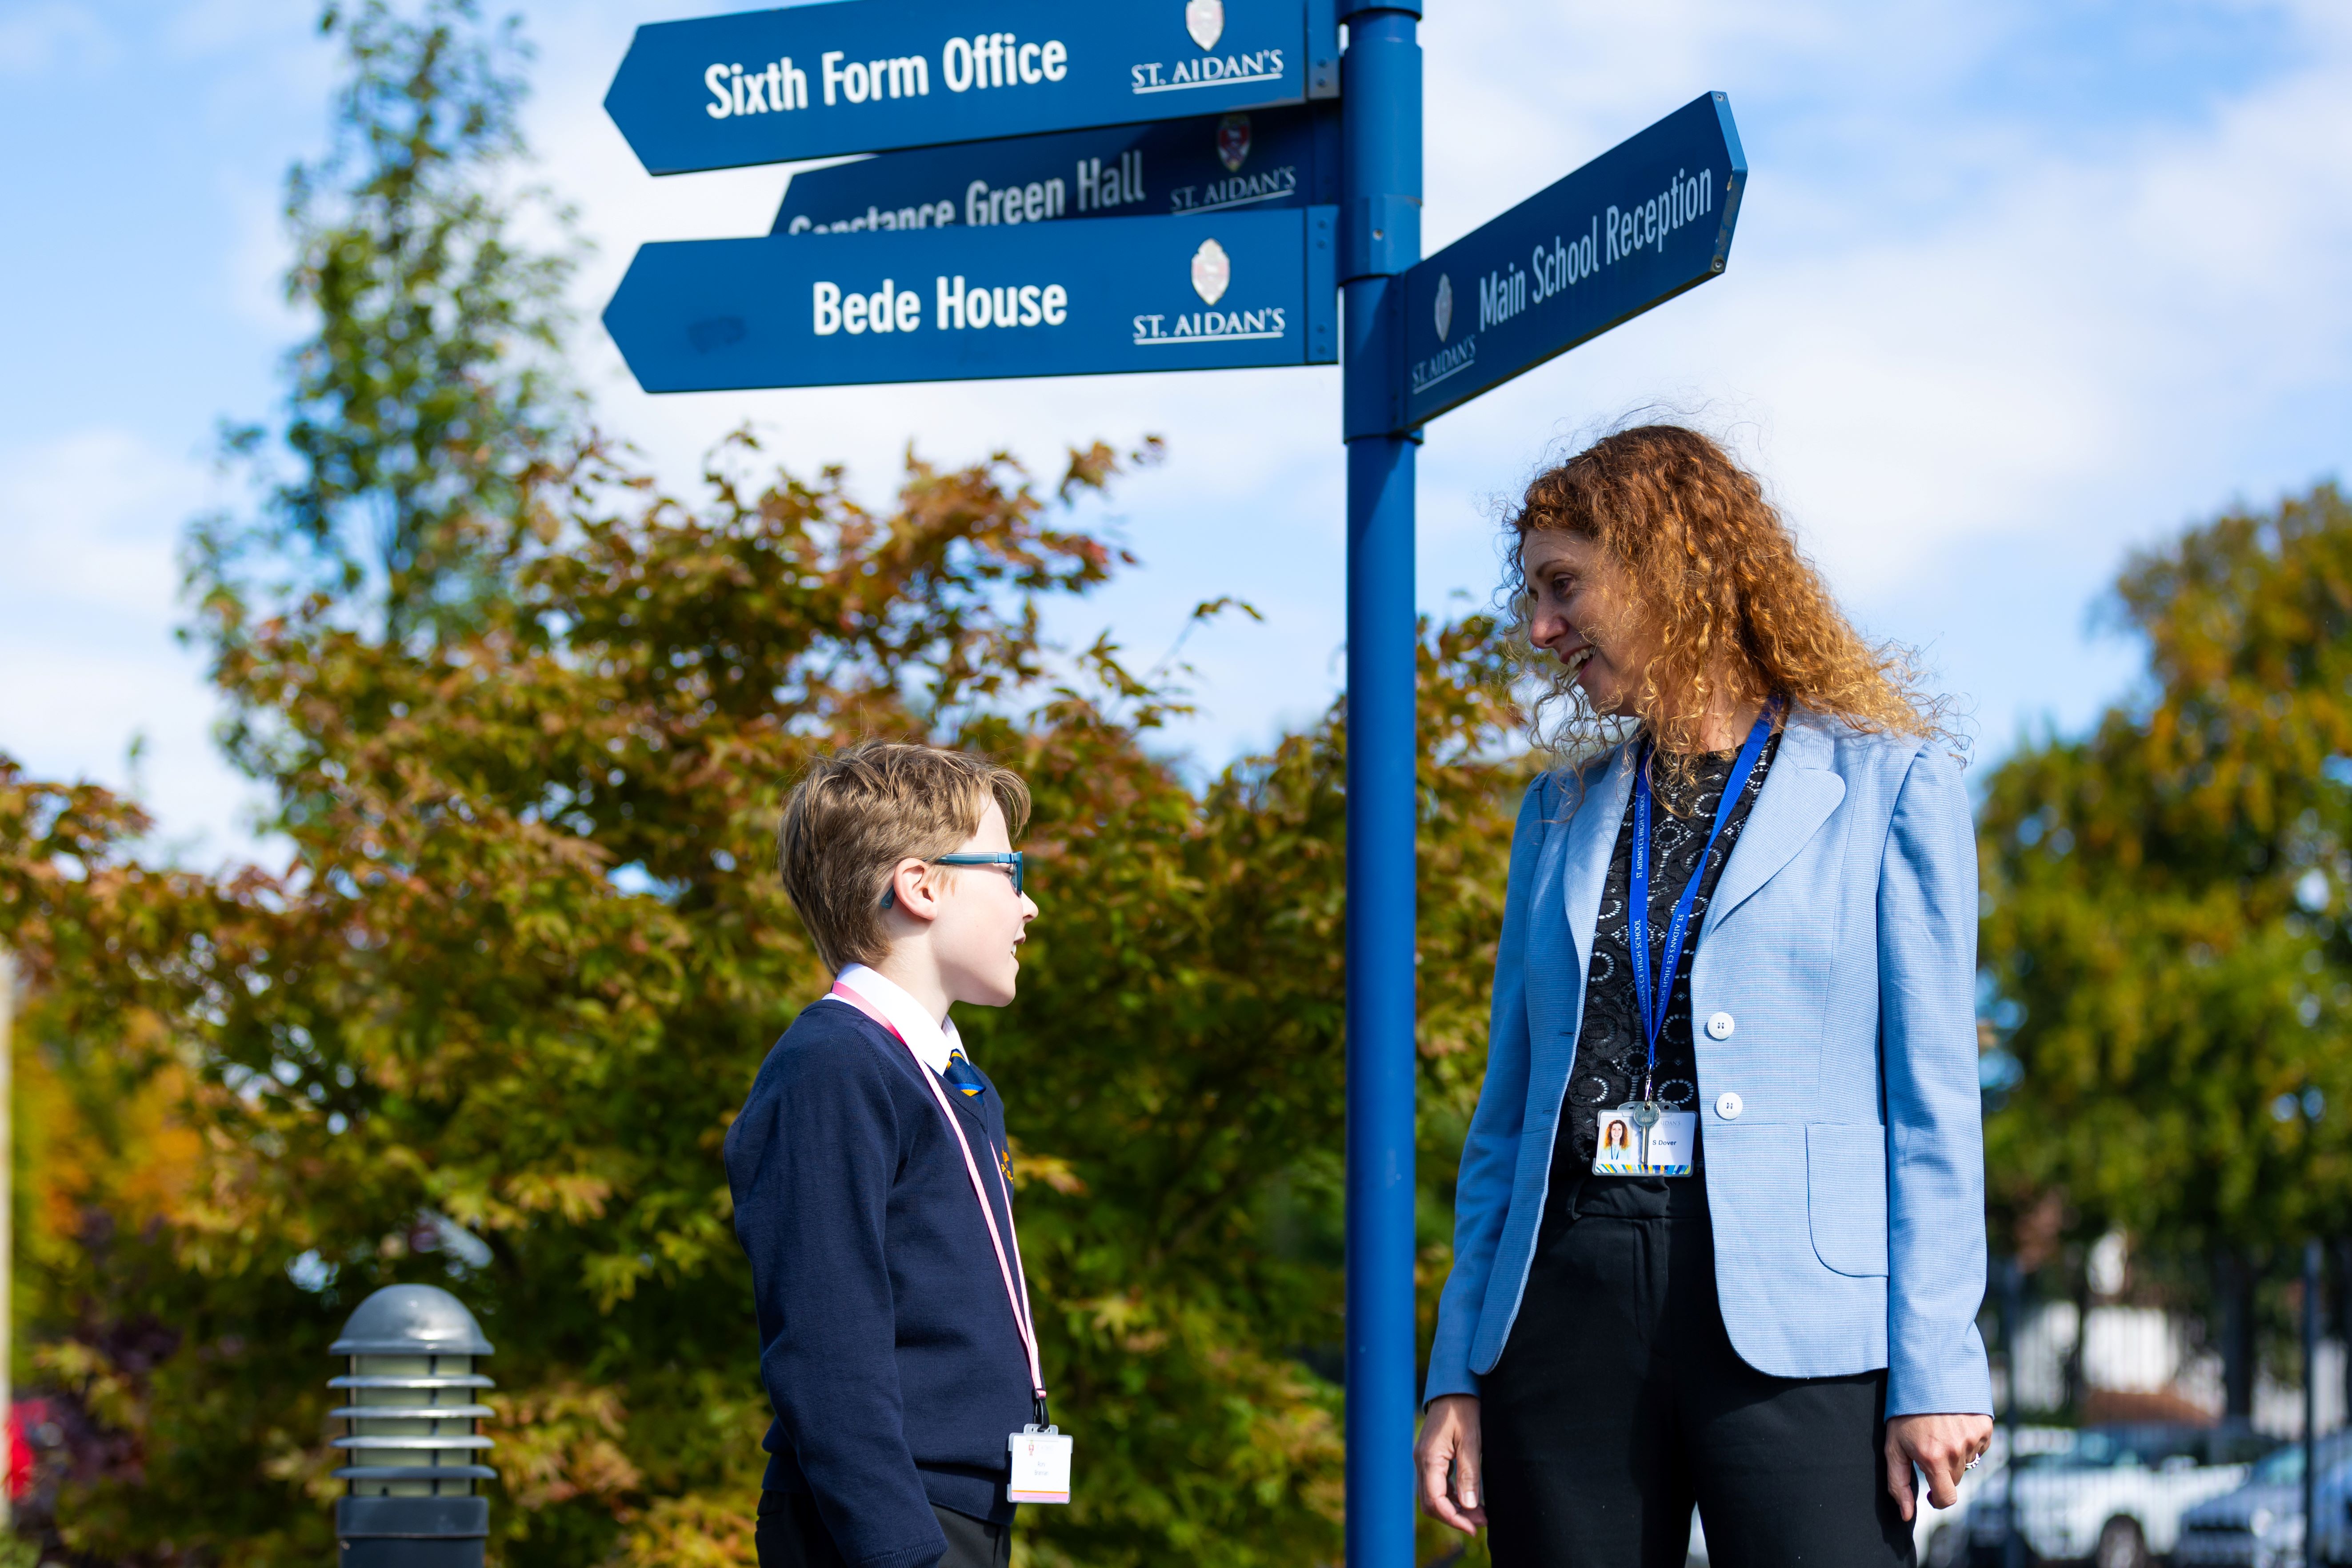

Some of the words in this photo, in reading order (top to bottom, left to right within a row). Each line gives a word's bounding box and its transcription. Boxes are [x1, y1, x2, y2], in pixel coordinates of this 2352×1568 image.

[704, 56, 808, 120] Sixth
[821, 50, 930, 106] Form
[942, 32, 1068, 93] Office
[1131, 62, 1167, 88] ST.
[1172, 49, 1284, 84] AIDAN'S
[965, 179, 1065, 227] Green
[1076, 151, 1145, 210] Hall
[1170, 186, 1199, 212] ST.
[1204, 166, 1296, 204] AIDAN'S
[1480, 262, 1526, 333] Main
[1532, 216, 1599, 304] School
[1606, 168, 1712, 265] Reception
[813, 279, 921, 336] Bede
[936, 275, 1068, 330] House
[1133, 314, 1168, 340] ST.
[1174, 308, 1285, 337] AIDAN'S
[1428, 334, 1476, 379] AIDAN'S
[1638, 837, 1644, 845] CE
[1669, 924, 1681, 953] AIDAN'S
[1638, 973, 1644, 984] CE
[1662, 967, 1671, 987] HIGH
[1667, 955, 1674, 964] CE
